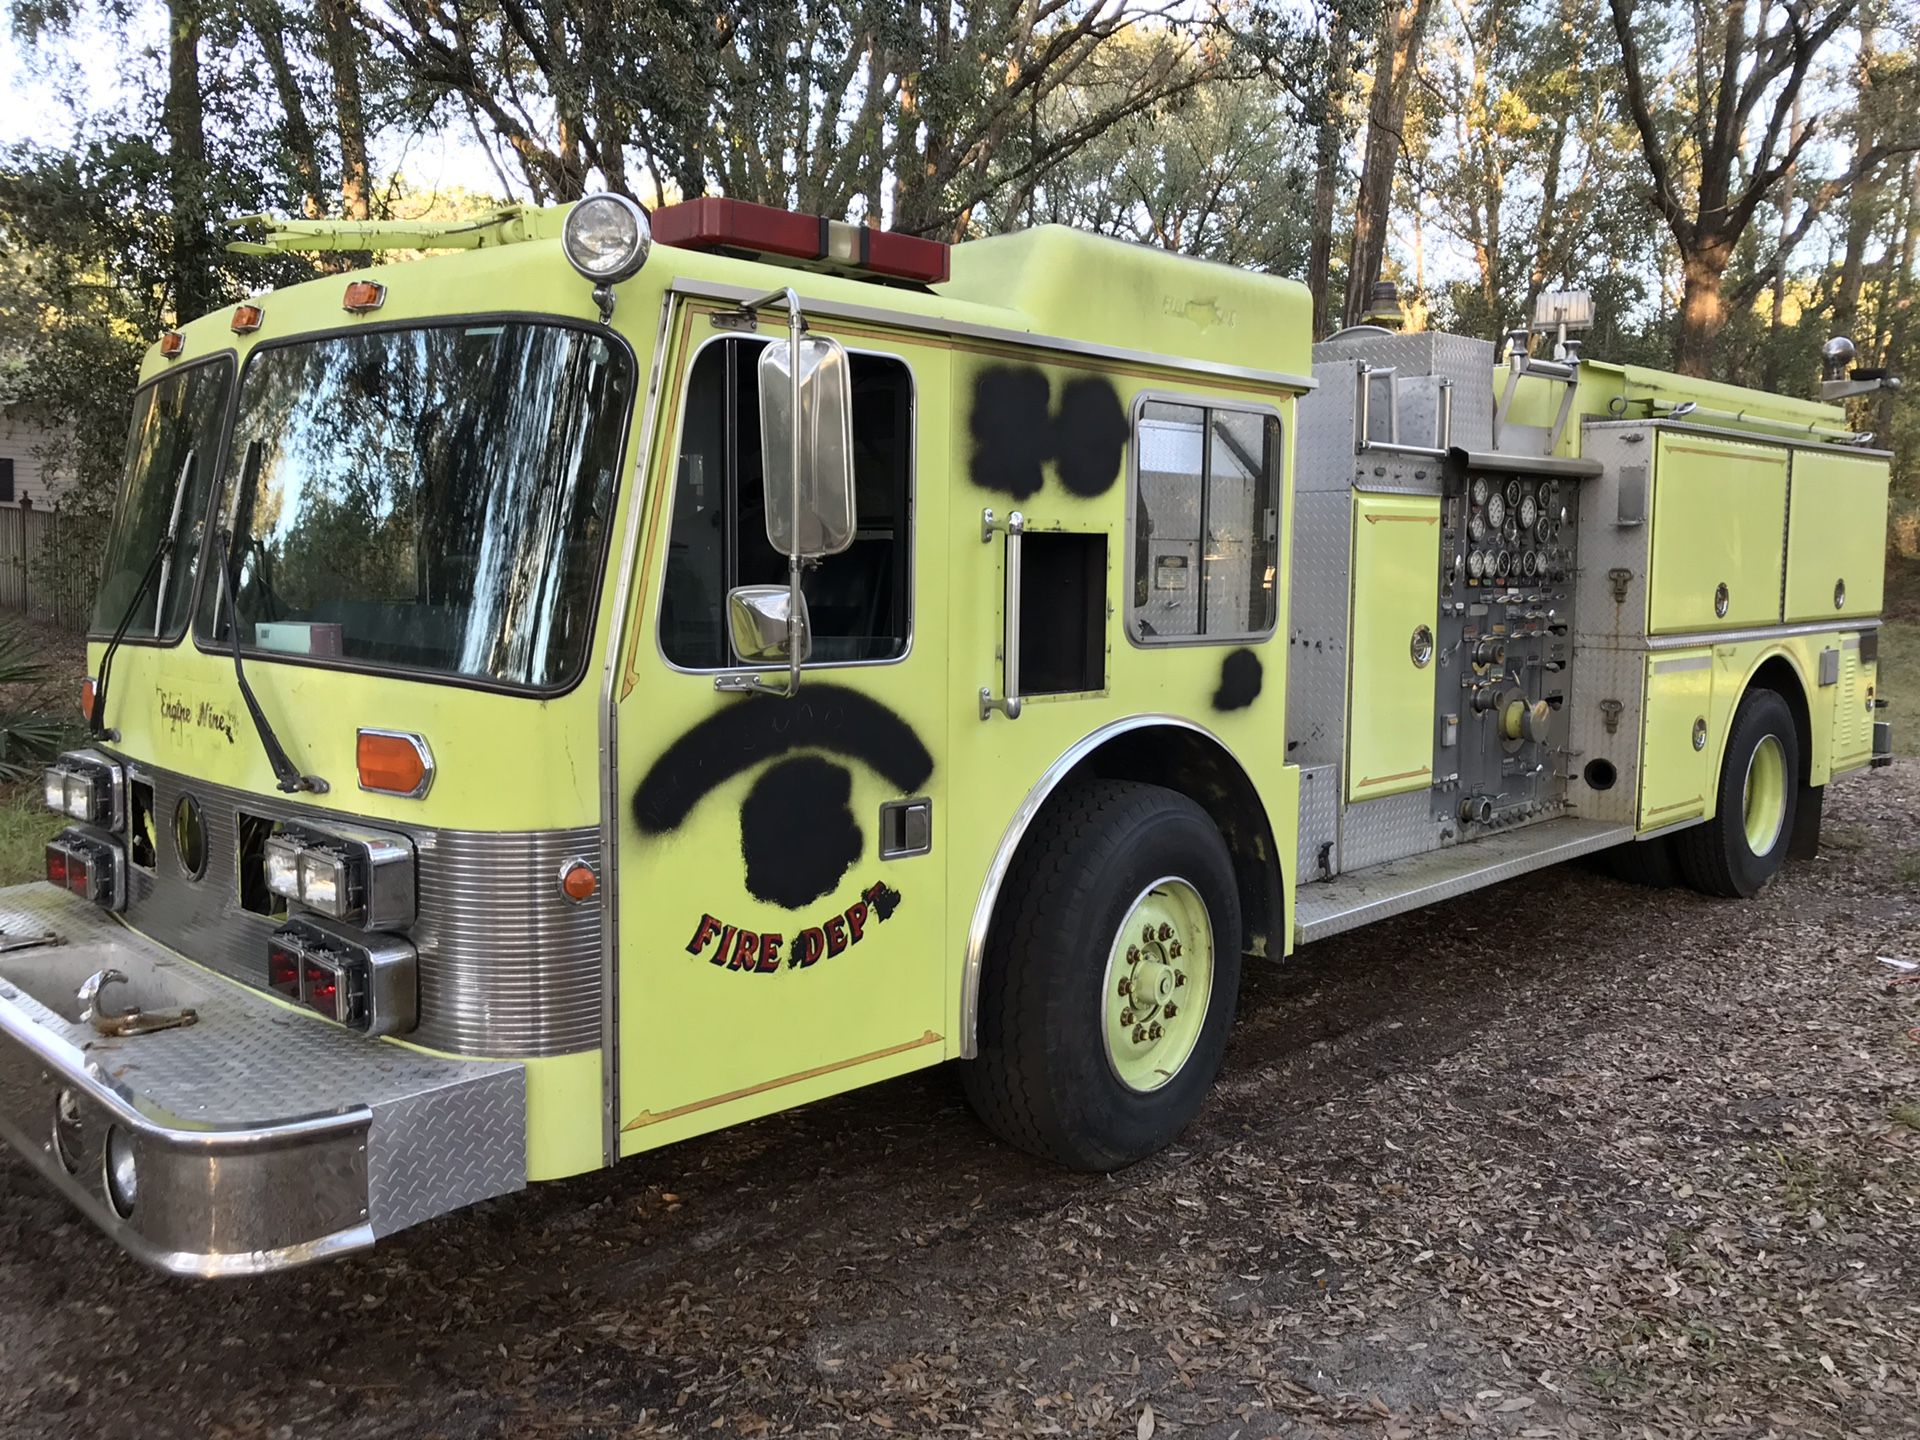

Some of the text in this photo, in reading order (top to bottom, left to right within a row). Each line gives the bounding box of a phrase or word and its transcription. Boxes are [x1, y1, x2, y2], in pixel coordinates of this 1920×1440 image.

[160, 692, 225, 732] Engine Nine
[685, 913, 783, 973] FIRE
